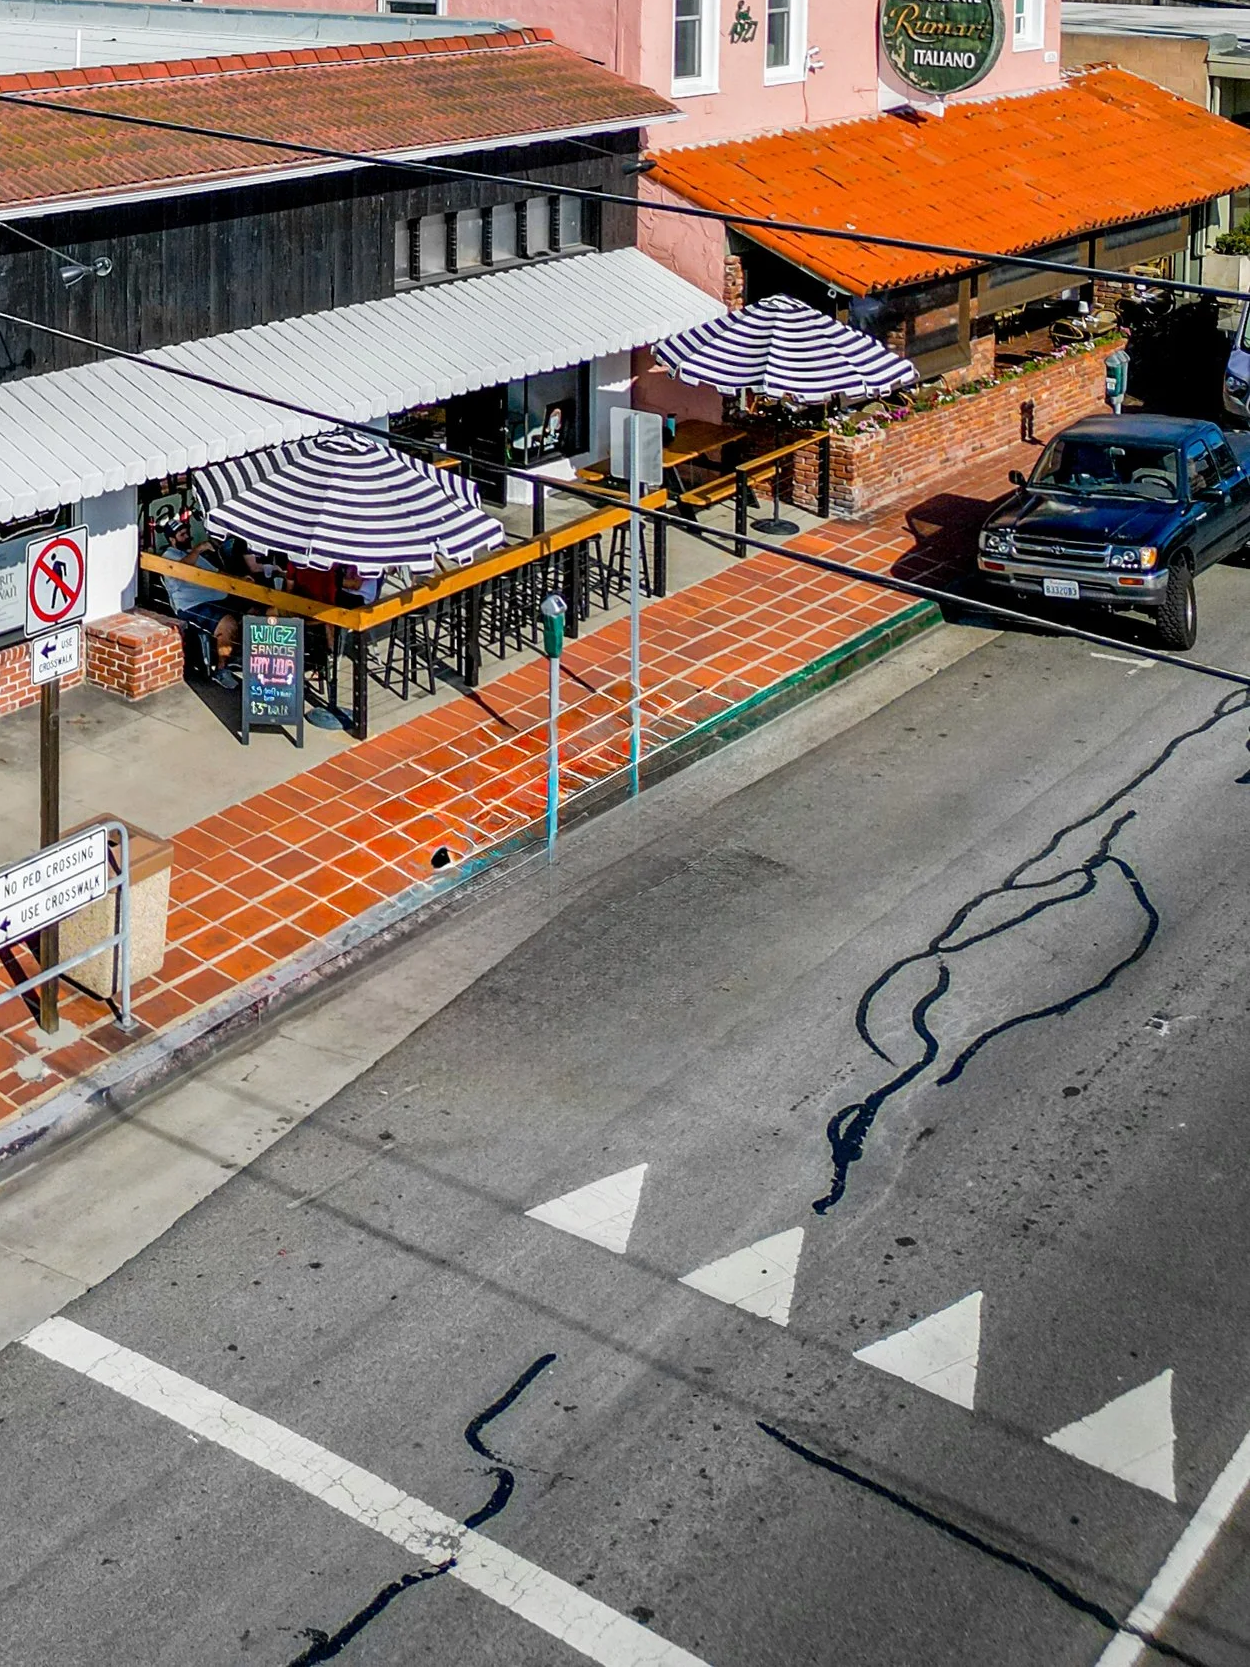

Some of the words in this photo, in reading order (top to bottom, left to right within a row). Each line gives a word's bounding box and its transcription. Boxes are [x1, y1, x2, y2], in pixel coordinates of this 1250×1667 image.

[913, 48, 976, 69] ITALIANO
[61, 637, 73, 649] USE
[250, 625, 297, 646] WIGZ
[251, 644, 295, 657] SANDOS
[38, 653, 73, 674] CROSSWALK
[4, 881, 18, 898] NO
[23, 870, 41, 890] PED
[46, 845, 94, 878] CROSSING
[20, 903, 40, 923] USE
[45, 874, 101, 911] CROSSWALK
